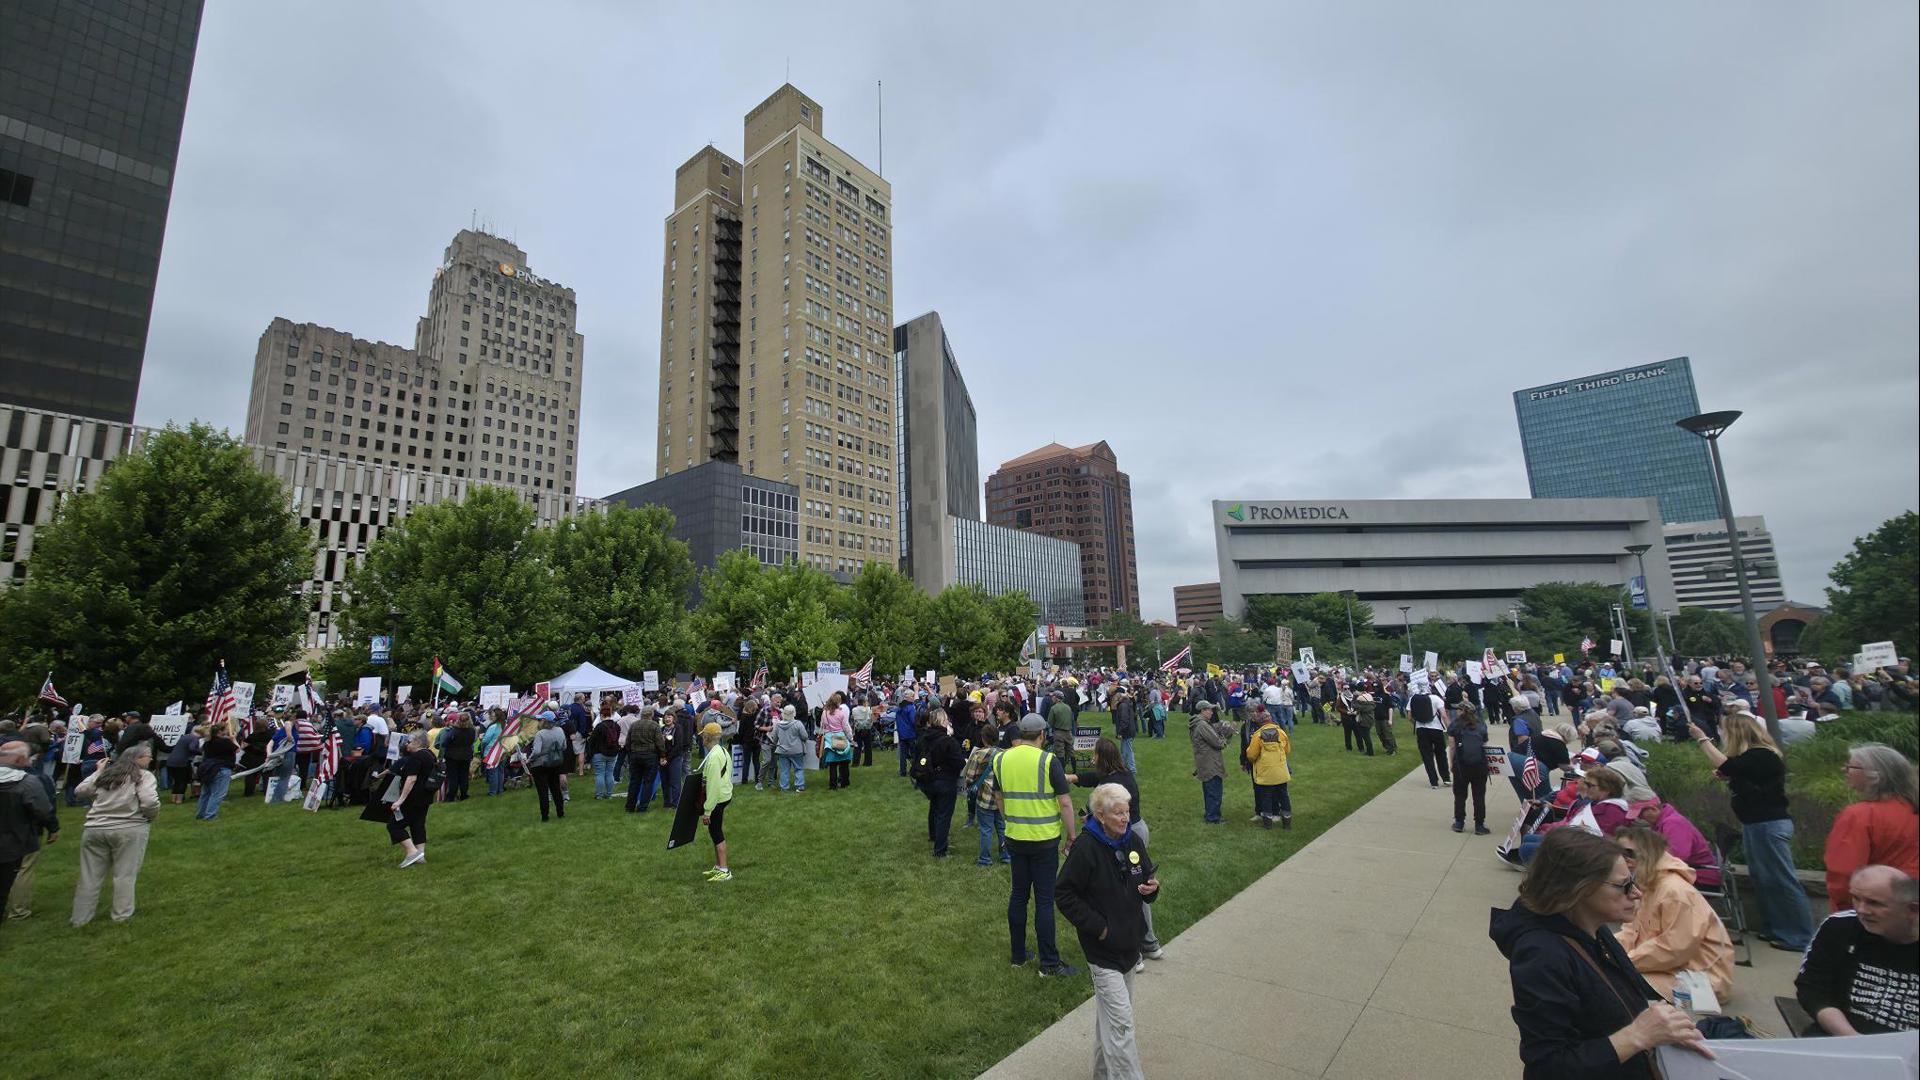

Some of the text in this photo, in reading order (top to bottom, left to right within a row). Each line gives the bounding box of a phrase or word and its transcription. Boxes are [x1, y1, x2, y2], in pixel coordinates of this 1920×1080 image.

[516, 269, 544, 288] PNC
[1530, 366, 1668, 401] FIFTH THIRD BANK
[1888, 978, 1899, 986] is
